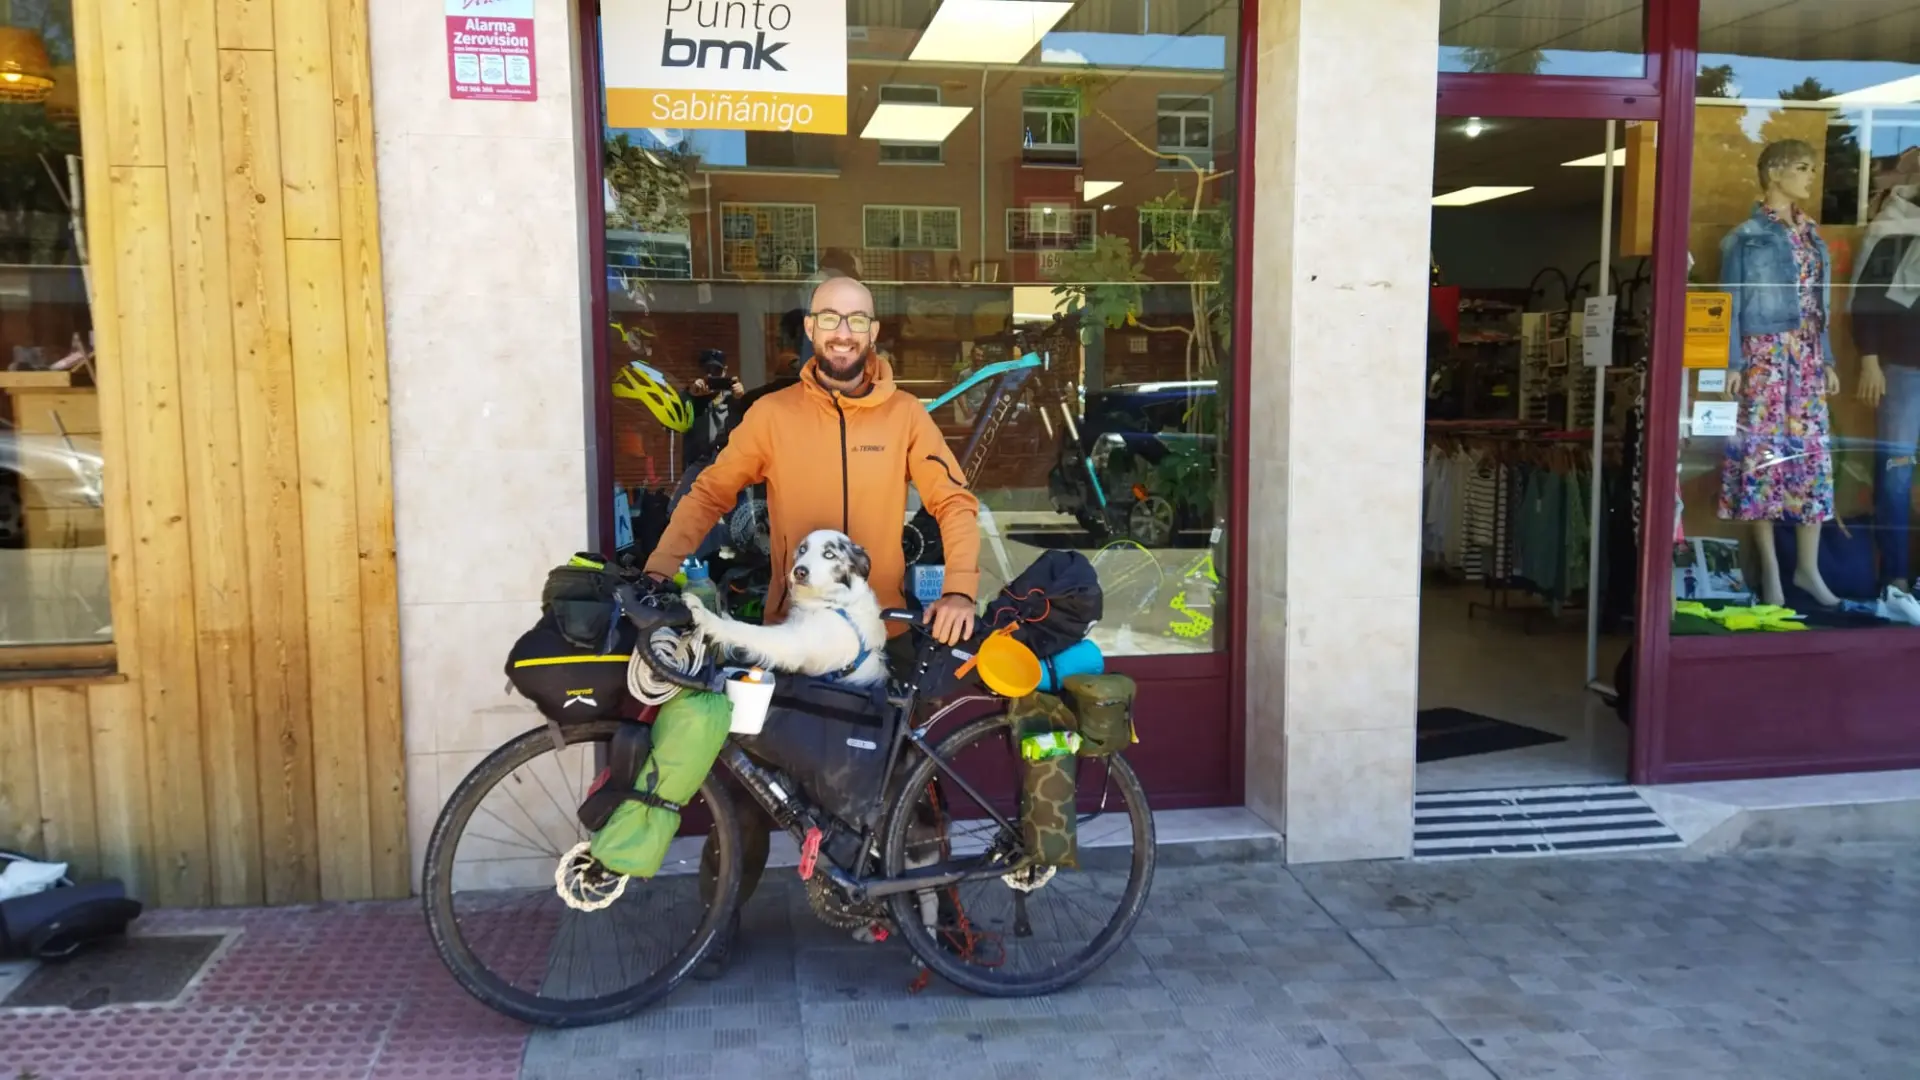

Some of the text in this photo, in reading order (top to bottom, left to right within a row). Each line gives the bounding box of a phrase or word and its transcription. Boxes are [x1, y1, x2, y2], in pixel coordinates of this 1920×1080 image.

[465, 18, 517, 33] Alarma
[665, 0, 792, 31] Punto
[453, 31, 529, 47] Zerovision
[661, 28, 791, 72] bmk
[651, 93, 814, 131] Sabiñánigo
